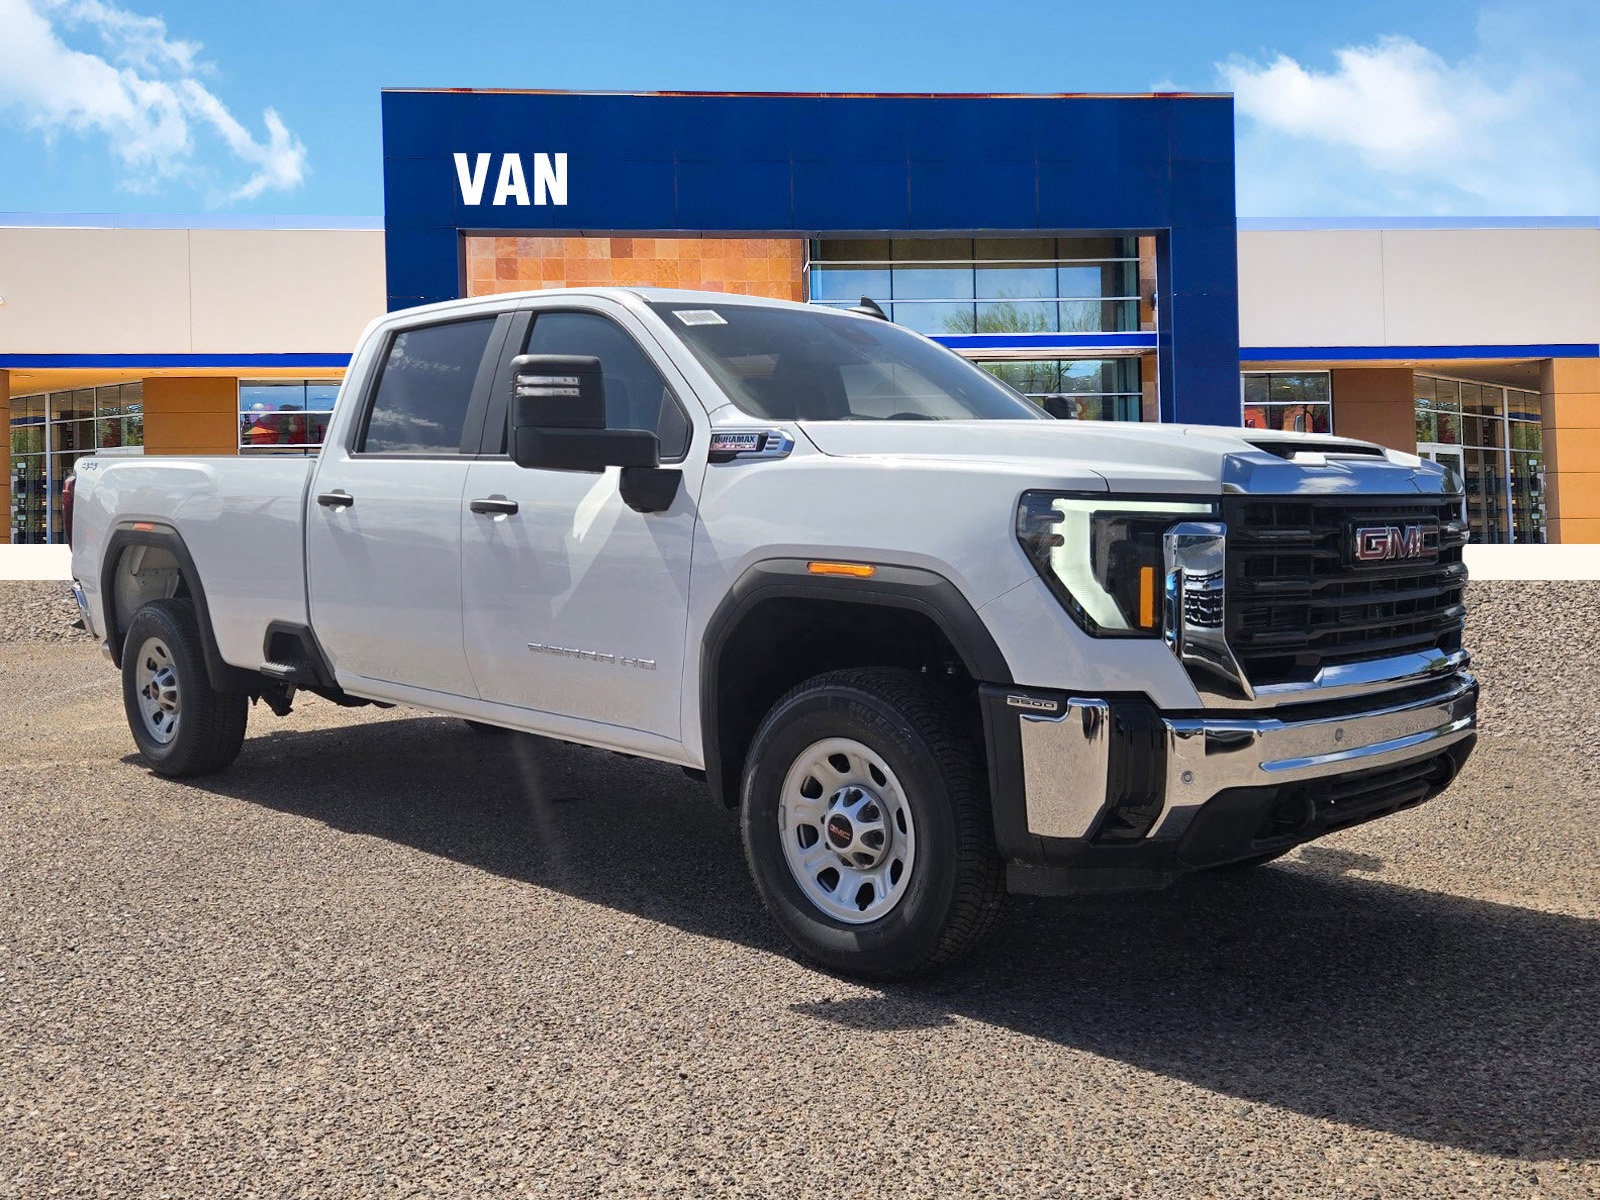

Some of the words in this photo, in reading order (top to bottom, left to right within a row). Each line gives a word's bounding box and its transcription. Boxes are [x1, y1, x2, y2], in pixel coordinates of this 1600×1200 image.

[452, 152, 568, 206] VAN
[1355, 525, 1439, 560] GMC
[1006, 695, 1058, 711] 3500
